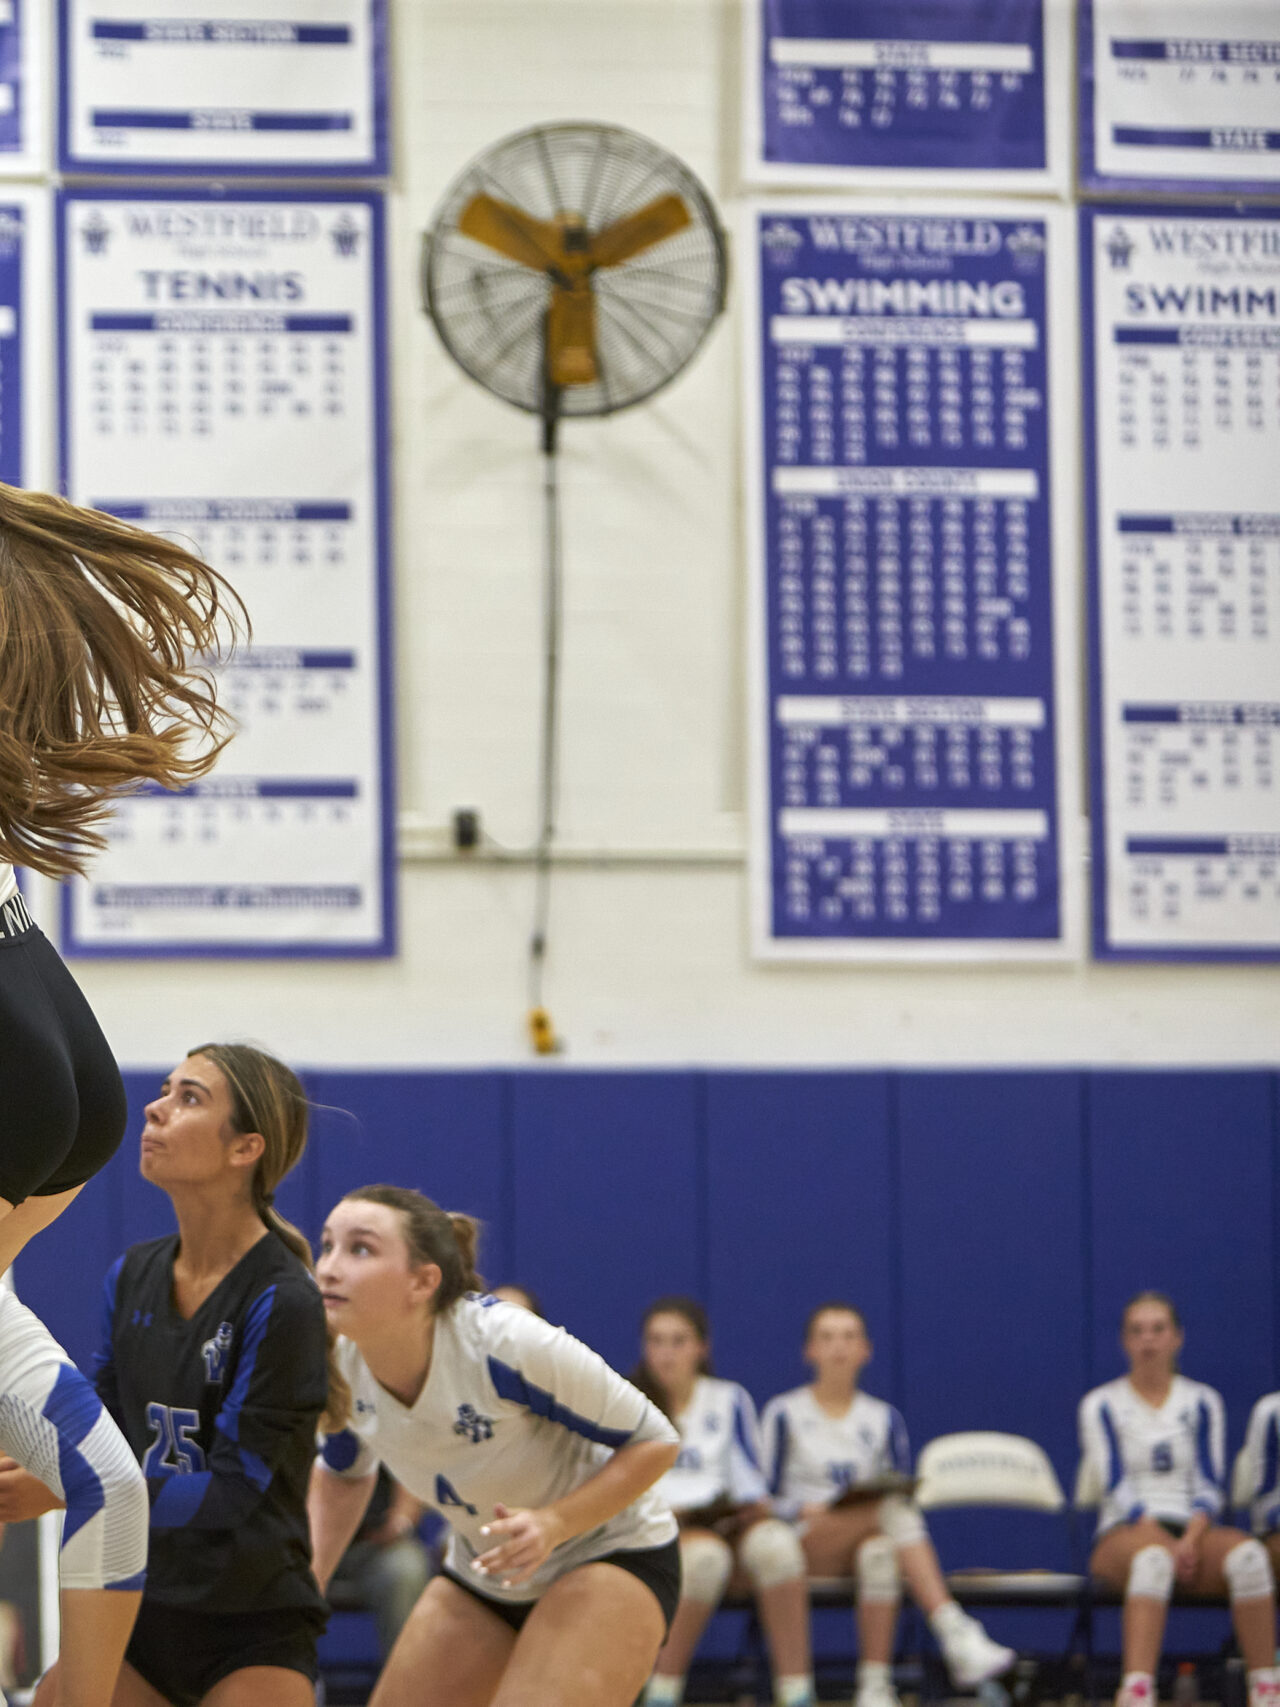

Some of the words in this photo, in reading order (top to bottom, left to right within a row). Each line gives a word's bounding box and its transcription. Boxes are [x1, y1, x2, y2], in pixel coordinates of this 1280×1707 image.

[124, 208, 320, 242] WESTFIELD
[807, 218, 1002, 255] WESTFIELD
[139, 268, 305, 302] TENNIS
[782, 277, 1025, 316] SWIMMING
[142, 1401, 206, 1476] 25
[435, 1473, 478, 1516] 4
